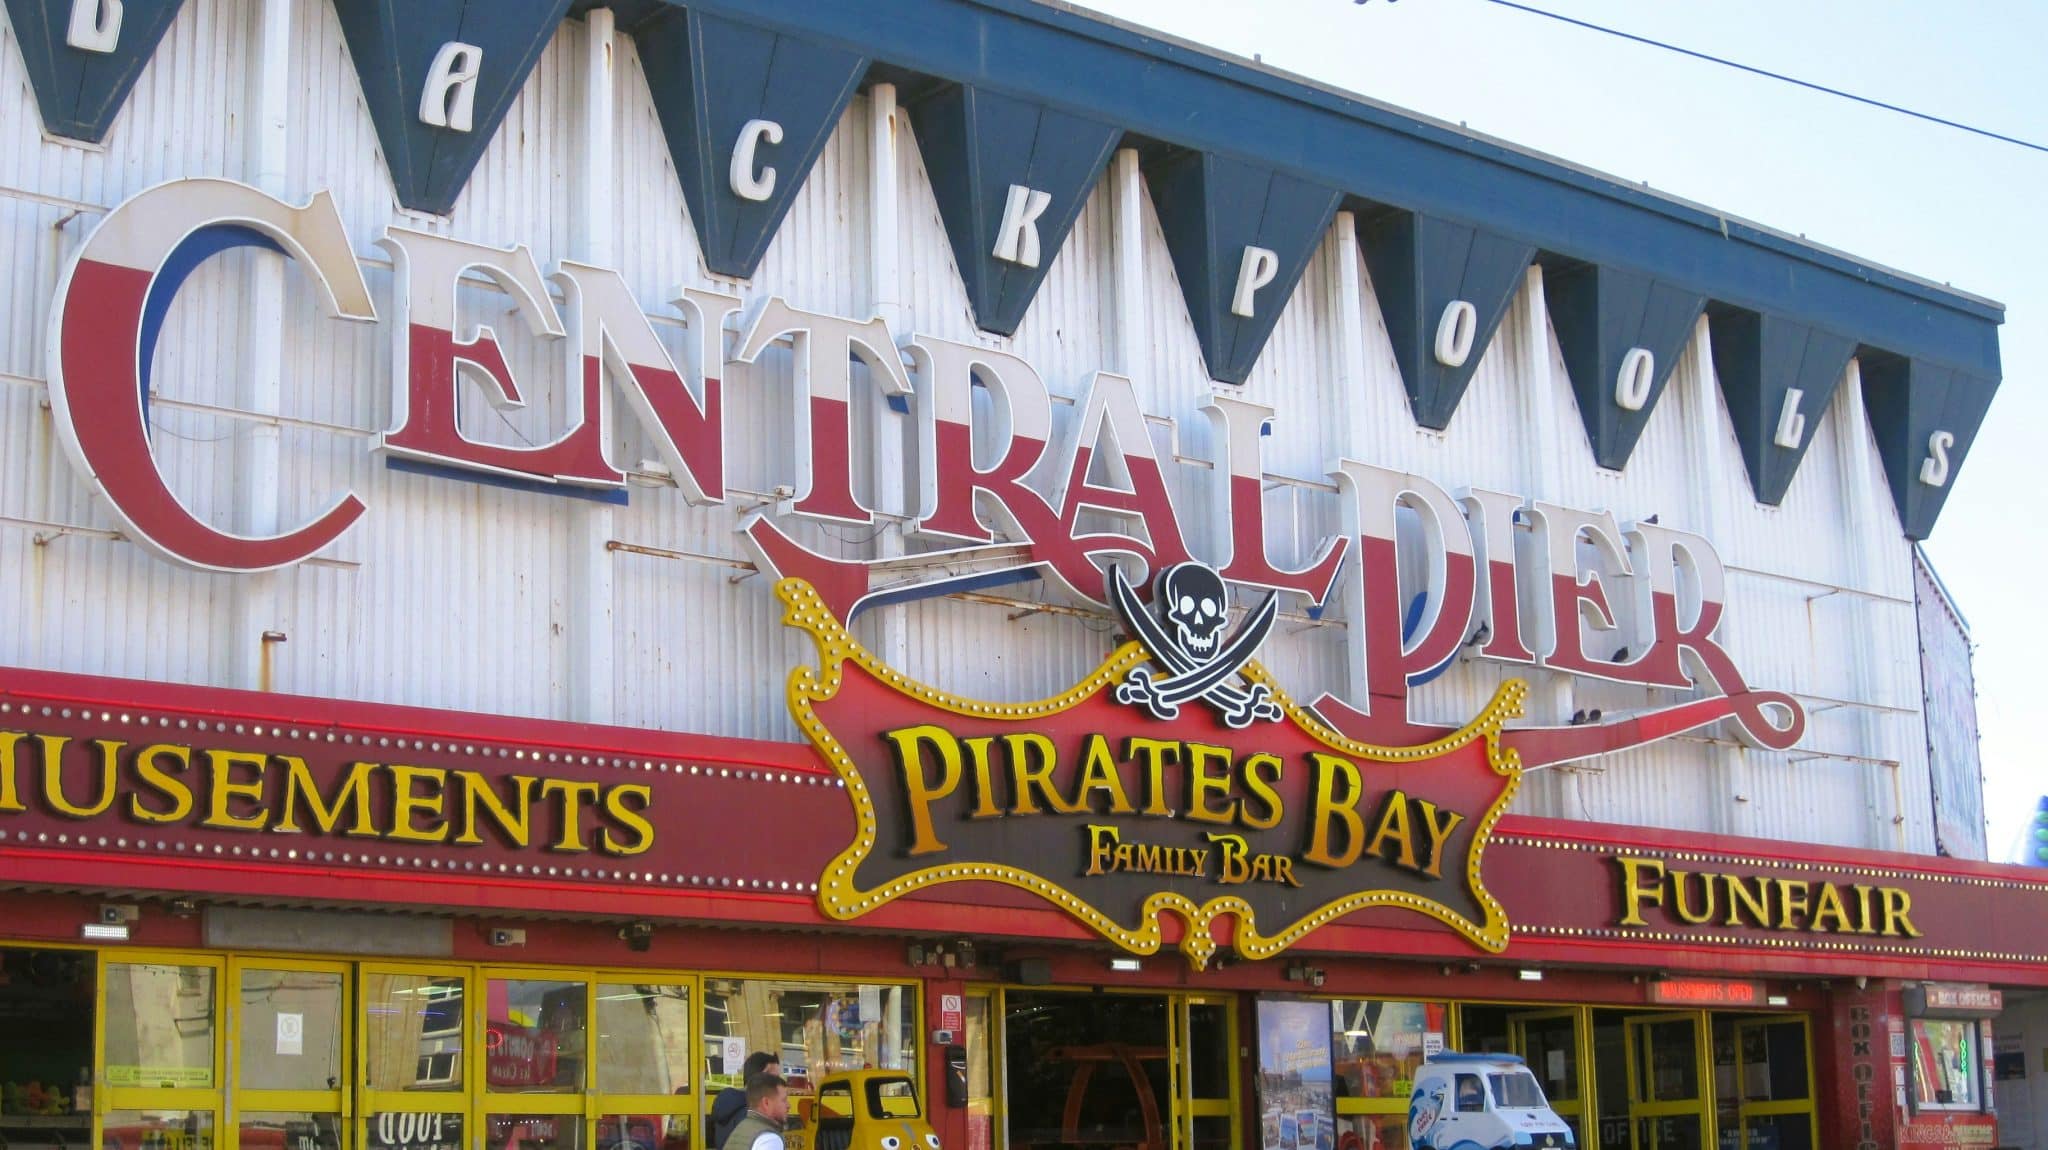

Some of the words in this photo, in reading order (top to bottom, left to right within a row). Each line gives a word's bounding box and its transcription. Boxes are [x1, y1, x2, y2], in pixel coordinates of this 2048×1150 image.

[46, 177, 1350, 622] CENTRAL
[1311, 457, 1805, 772] PIER
[0, 730, 655, 856] USEMENTS
[886, 724, 1284, 856] PIRATES
[1303, 751, 1465, 879] BAY
[1085, 823, 1209, 877] FAMILY
[1206, 831, 1304, 888] BAR
[1616, 856, 1924, 937] FUNFAIR
[1937, 991, 1957, 1005] BOX
[1959, 991, 1992, 1007] OFFICE
